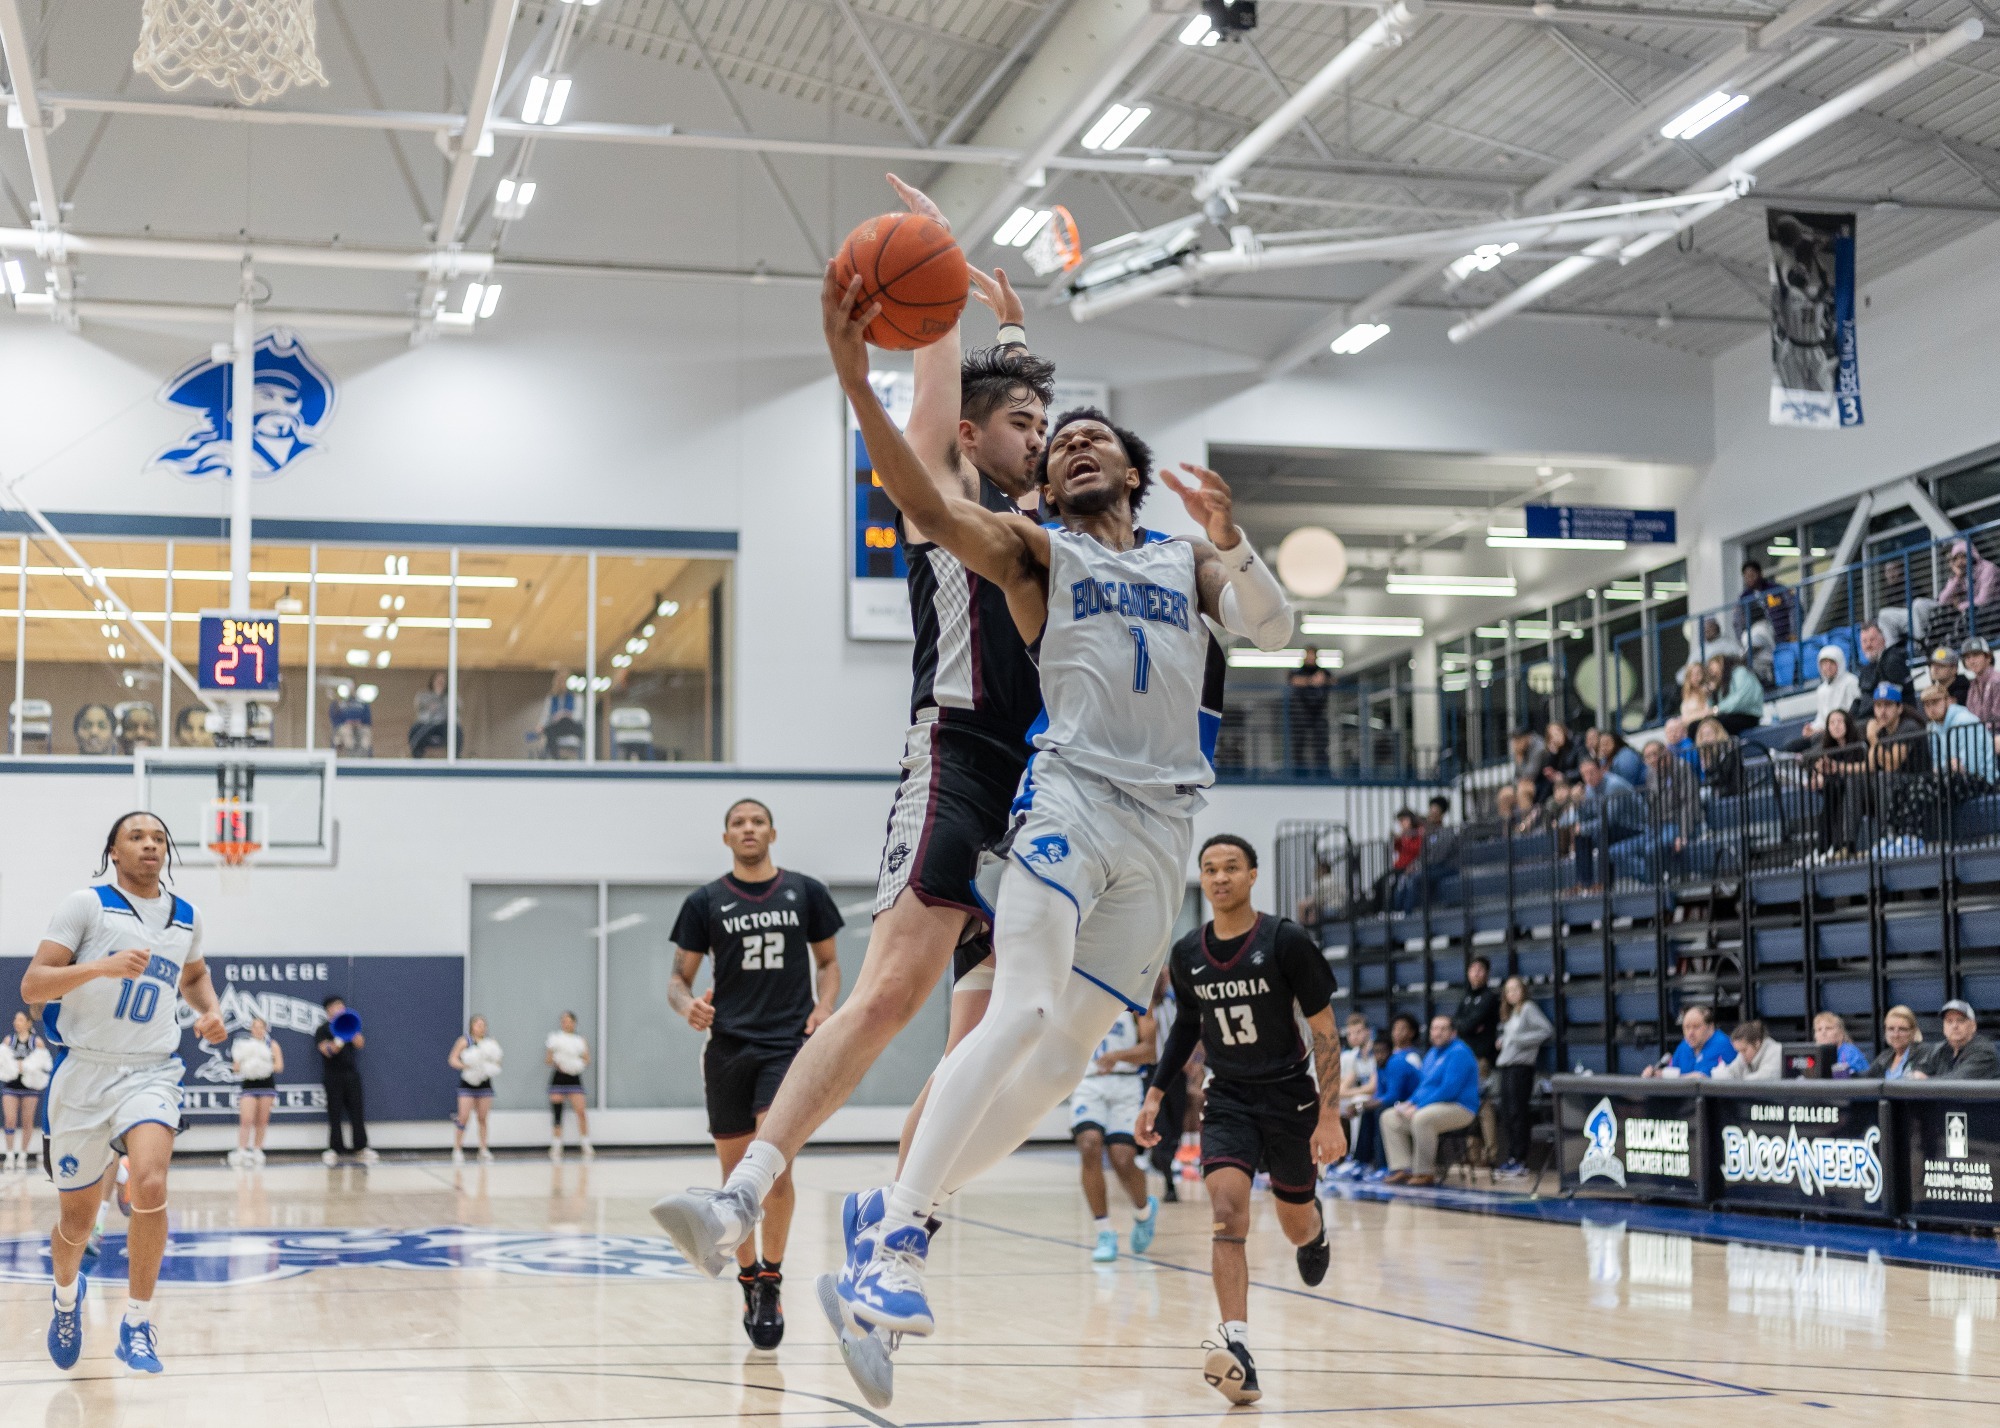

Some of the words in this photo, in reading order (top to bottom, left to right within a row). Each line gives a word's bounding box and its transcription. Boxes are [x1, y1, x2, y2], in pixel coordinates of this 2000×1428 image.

[1842, 397, 1859, 426] 3
[222, 619, 274, 646] 3:44
[214, 643, 264, 686] 27
[1128, 625, 1151, 694] 1
[722, 910, 800, 934] VICTORIA
[742, 932, 785, 970] 22
[225, 963, 329, 981] COLLEGE
[114, 977, 160, 1023] 10
[1194, 977, 1270, 1000] VICTORIA
[1214, 1004, 1259, 1046] 13
[1750, 1104, 1784, 1121] BLINN
[1788, 1105, 1839, 1123] COLLEGE
[1625, 1117, 1689, 1152] BUCCANEER
[1663, 1152, 1690, 1177] CLUB
[1720, 1123, 1883, 1203] BUCCANEERS
[1924, 1159, 1950, 1172] BLINN
[1952, 1161, 1990, 1174] COLLEGE
[1924, 1171, 1955, 1188] ALUMNI
[1961, 1174, 1993, 1191] FRIENDS
[1925, 1188, 1992, 1203] ASSOCIATION
